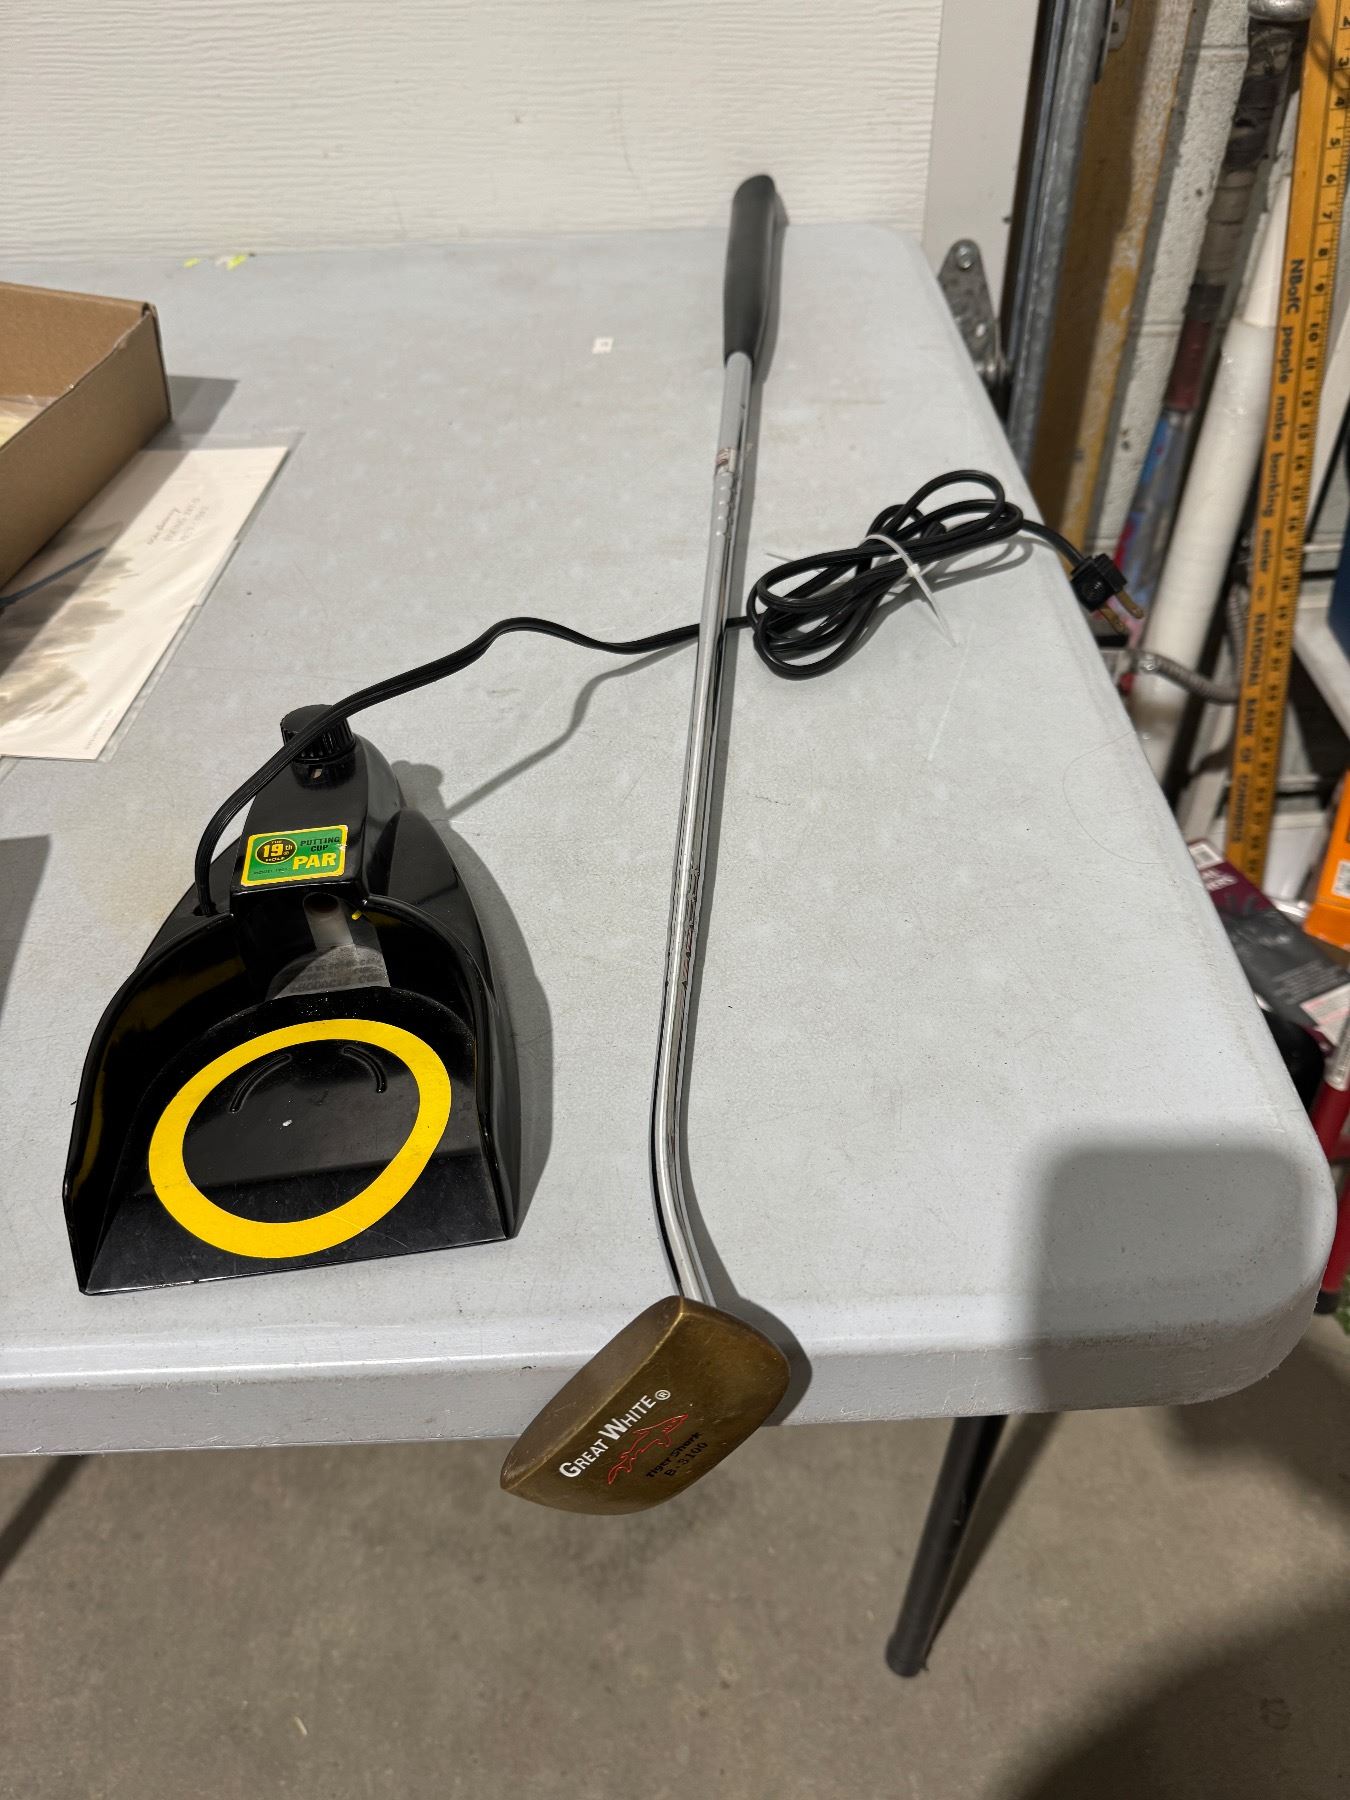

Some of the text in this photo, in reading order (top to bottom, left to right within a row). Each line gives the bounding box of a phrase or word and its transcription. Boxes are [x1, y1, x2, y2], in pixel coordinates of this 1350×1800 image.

[1286, 259, 1304, 315] NBofC
[1278, 326, 1294, 384] people
[1272, 396, 1288, 442] make
[292, 852, 337, 870] PAR
[300, 836, 341, 847] PUTTING
[310, 844, 329, 853] CUP
[559, 1438, 609, 1478] GREAT
[598, 1395, 657, 1441] WHITE
[645, 1432, 702, 1479] Tiger Shark
